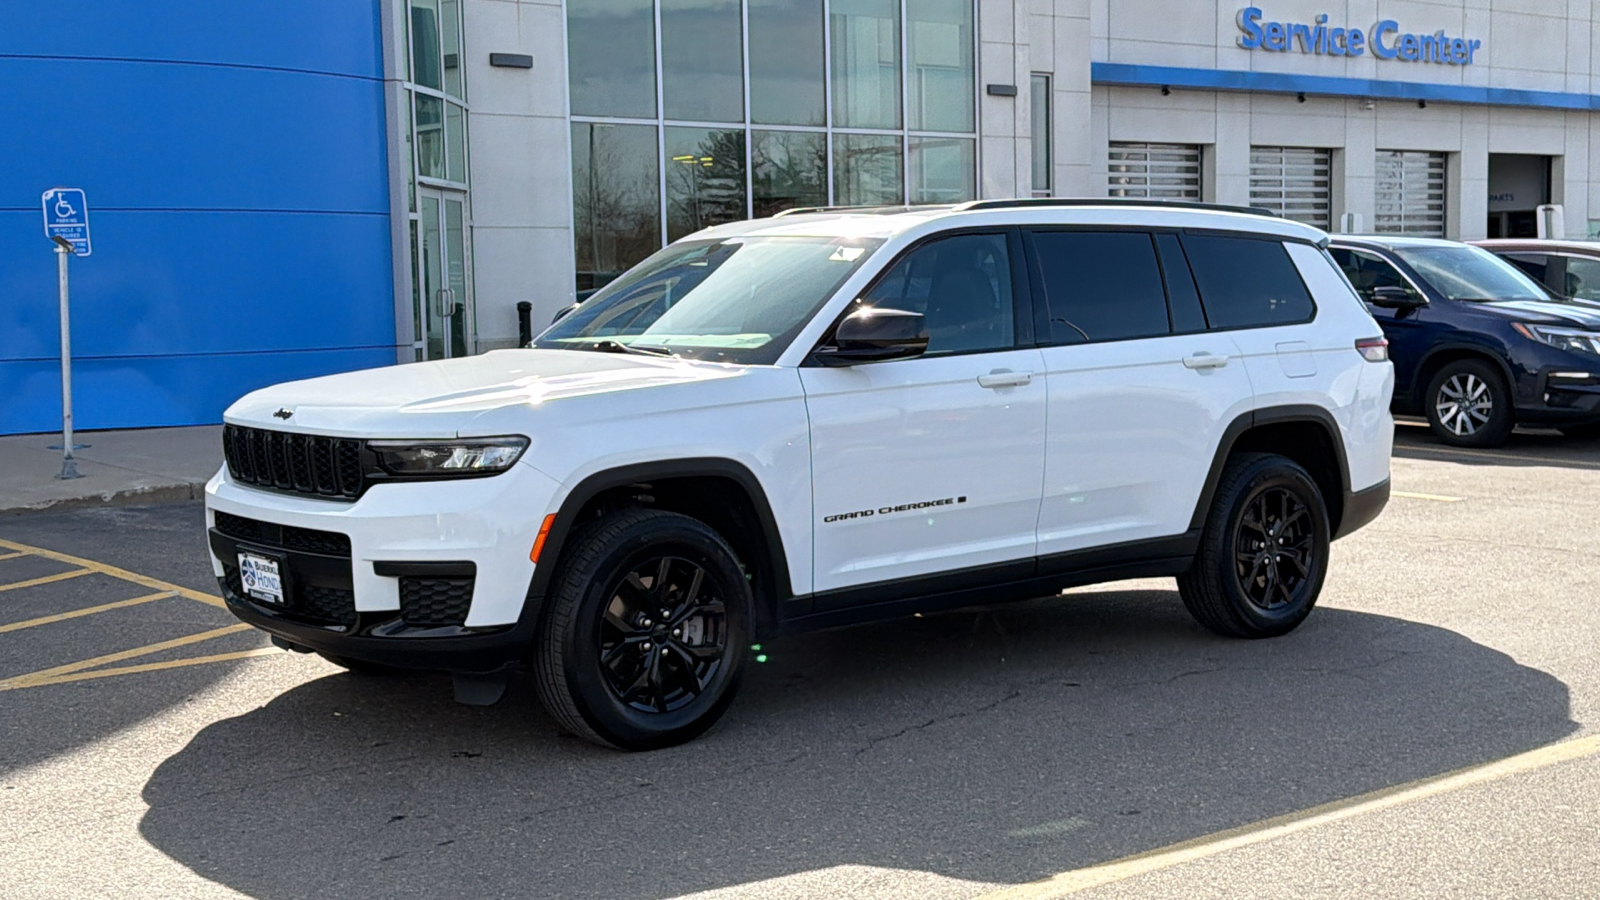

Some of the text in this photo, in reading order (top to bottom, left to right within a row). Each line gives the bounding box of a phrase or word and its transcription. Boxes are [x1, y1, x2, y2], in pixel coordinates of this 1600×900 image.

[1236, 7, 1481, 66] Service Center
[824, 497, 954, 523] GRAND CHEROKEE
[254, 560, 279, 575] BUERKL
[257, 571, 282, 590] HOND
